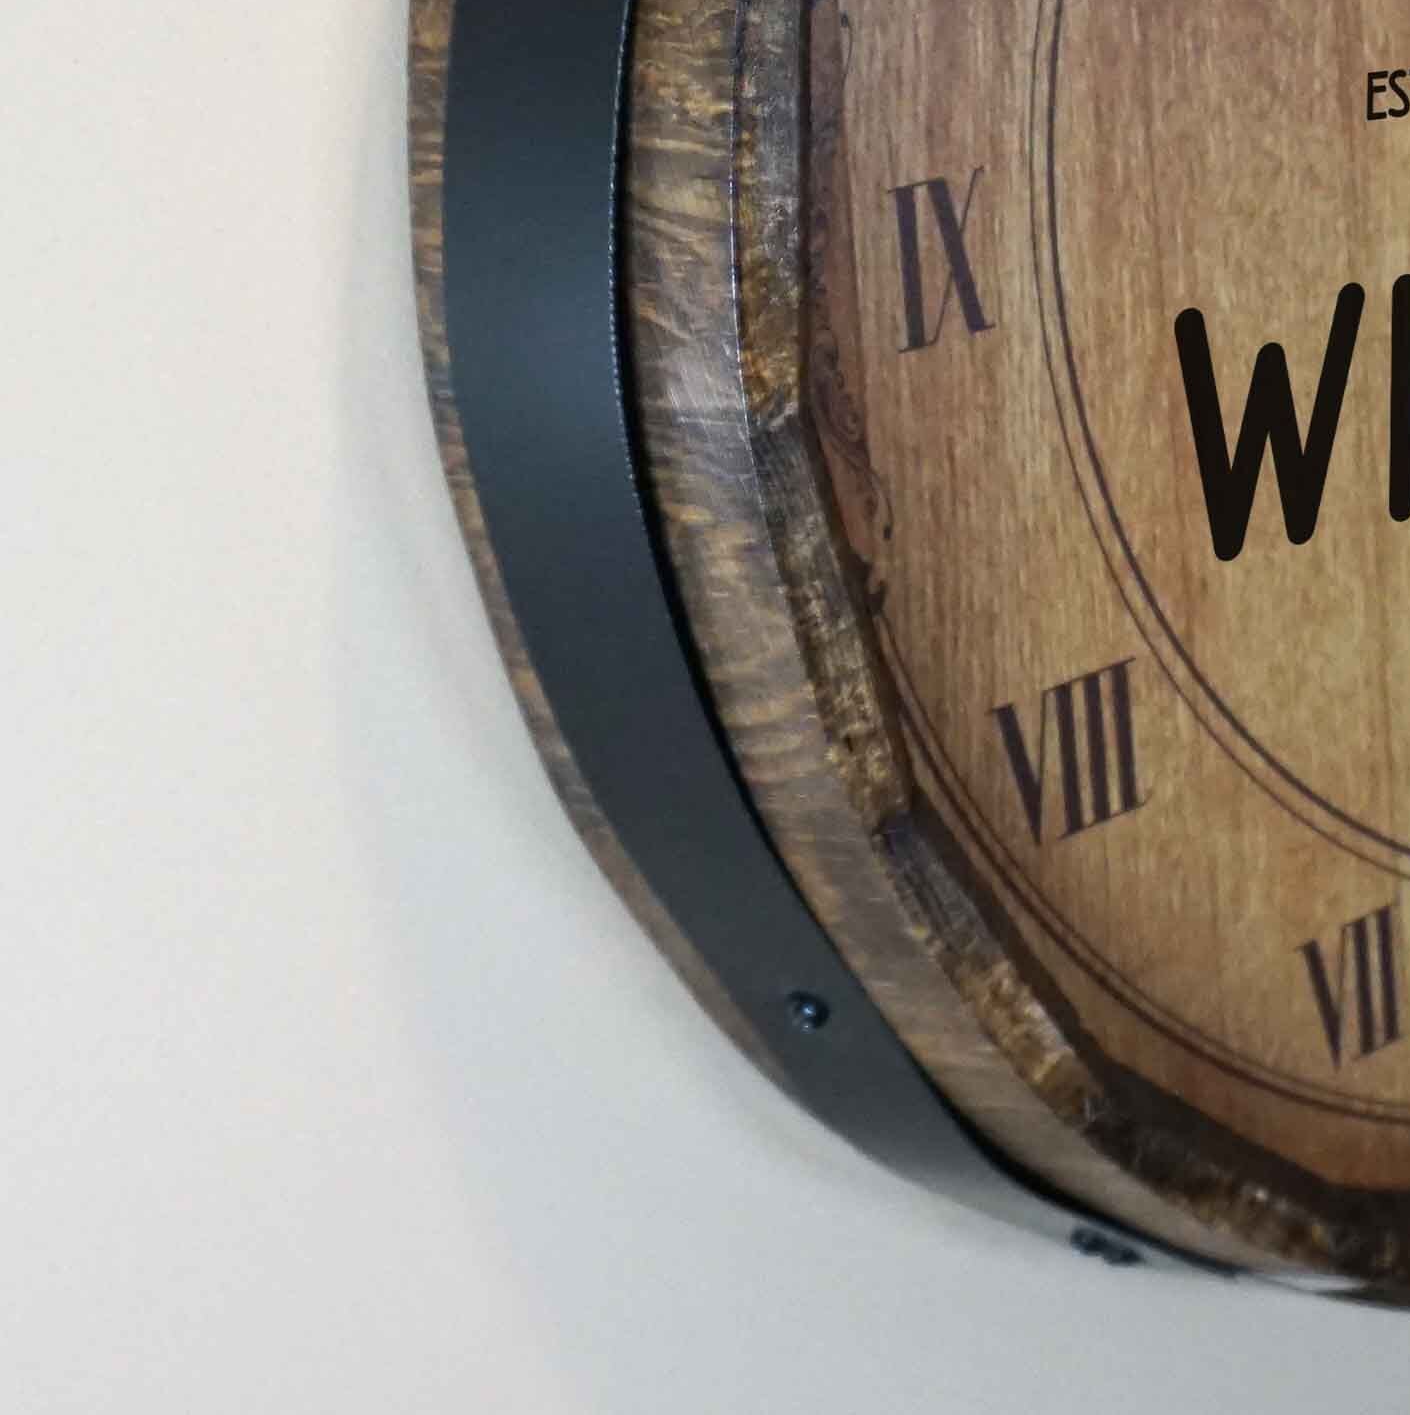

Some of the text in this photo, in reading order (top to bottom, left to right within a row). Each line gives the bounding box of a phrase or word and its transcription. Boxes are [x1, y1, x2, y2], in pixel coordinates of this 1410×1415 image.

[887, 166, 996, 355] IX
[986, 656, 1148, 846] VIII
[1295, 902, 1404, 1070] VII
